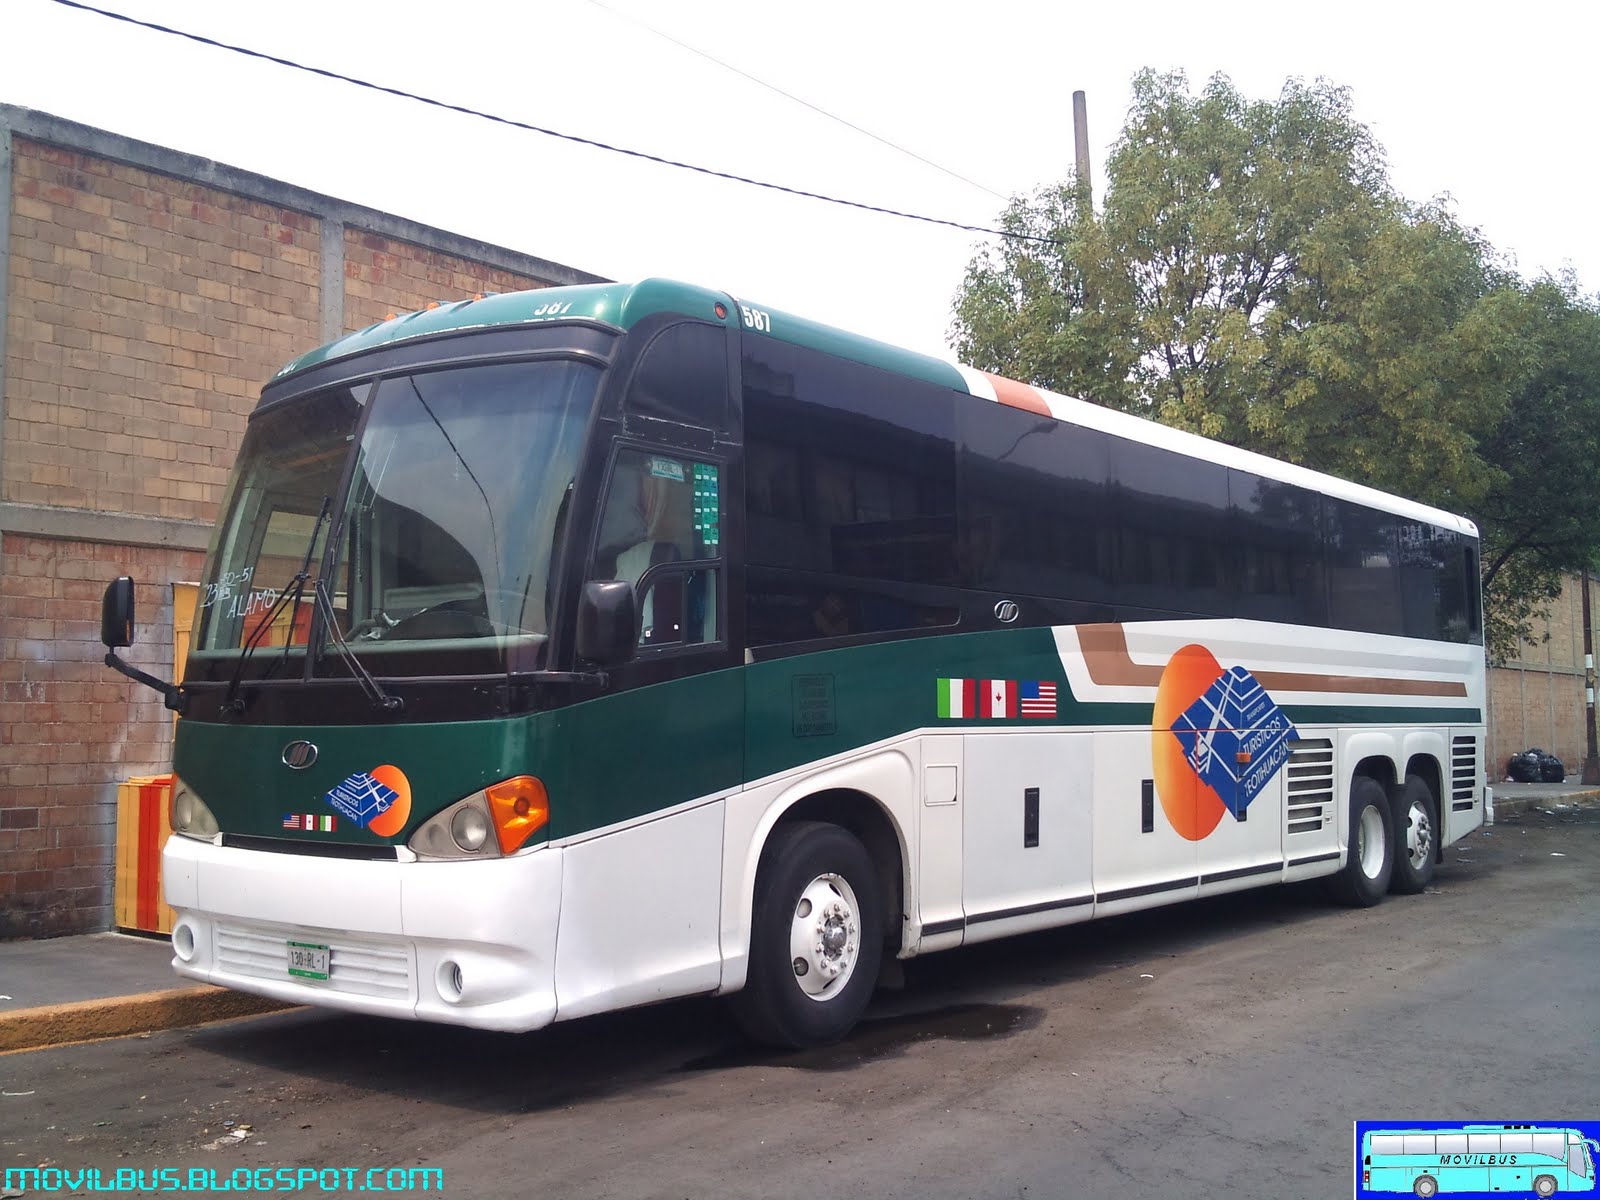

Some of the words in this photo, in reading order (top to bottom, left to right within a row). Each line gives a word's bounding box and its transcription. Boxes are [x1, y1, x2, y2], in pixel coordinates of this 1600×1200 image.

[741, 305, 771, 333] 587
[226, 588, 276, 618] ALAMO
[1242, 716, 1281, 755] TURISTICOS
[1244, 738, 1289, 797] TEOTIHUACAN
